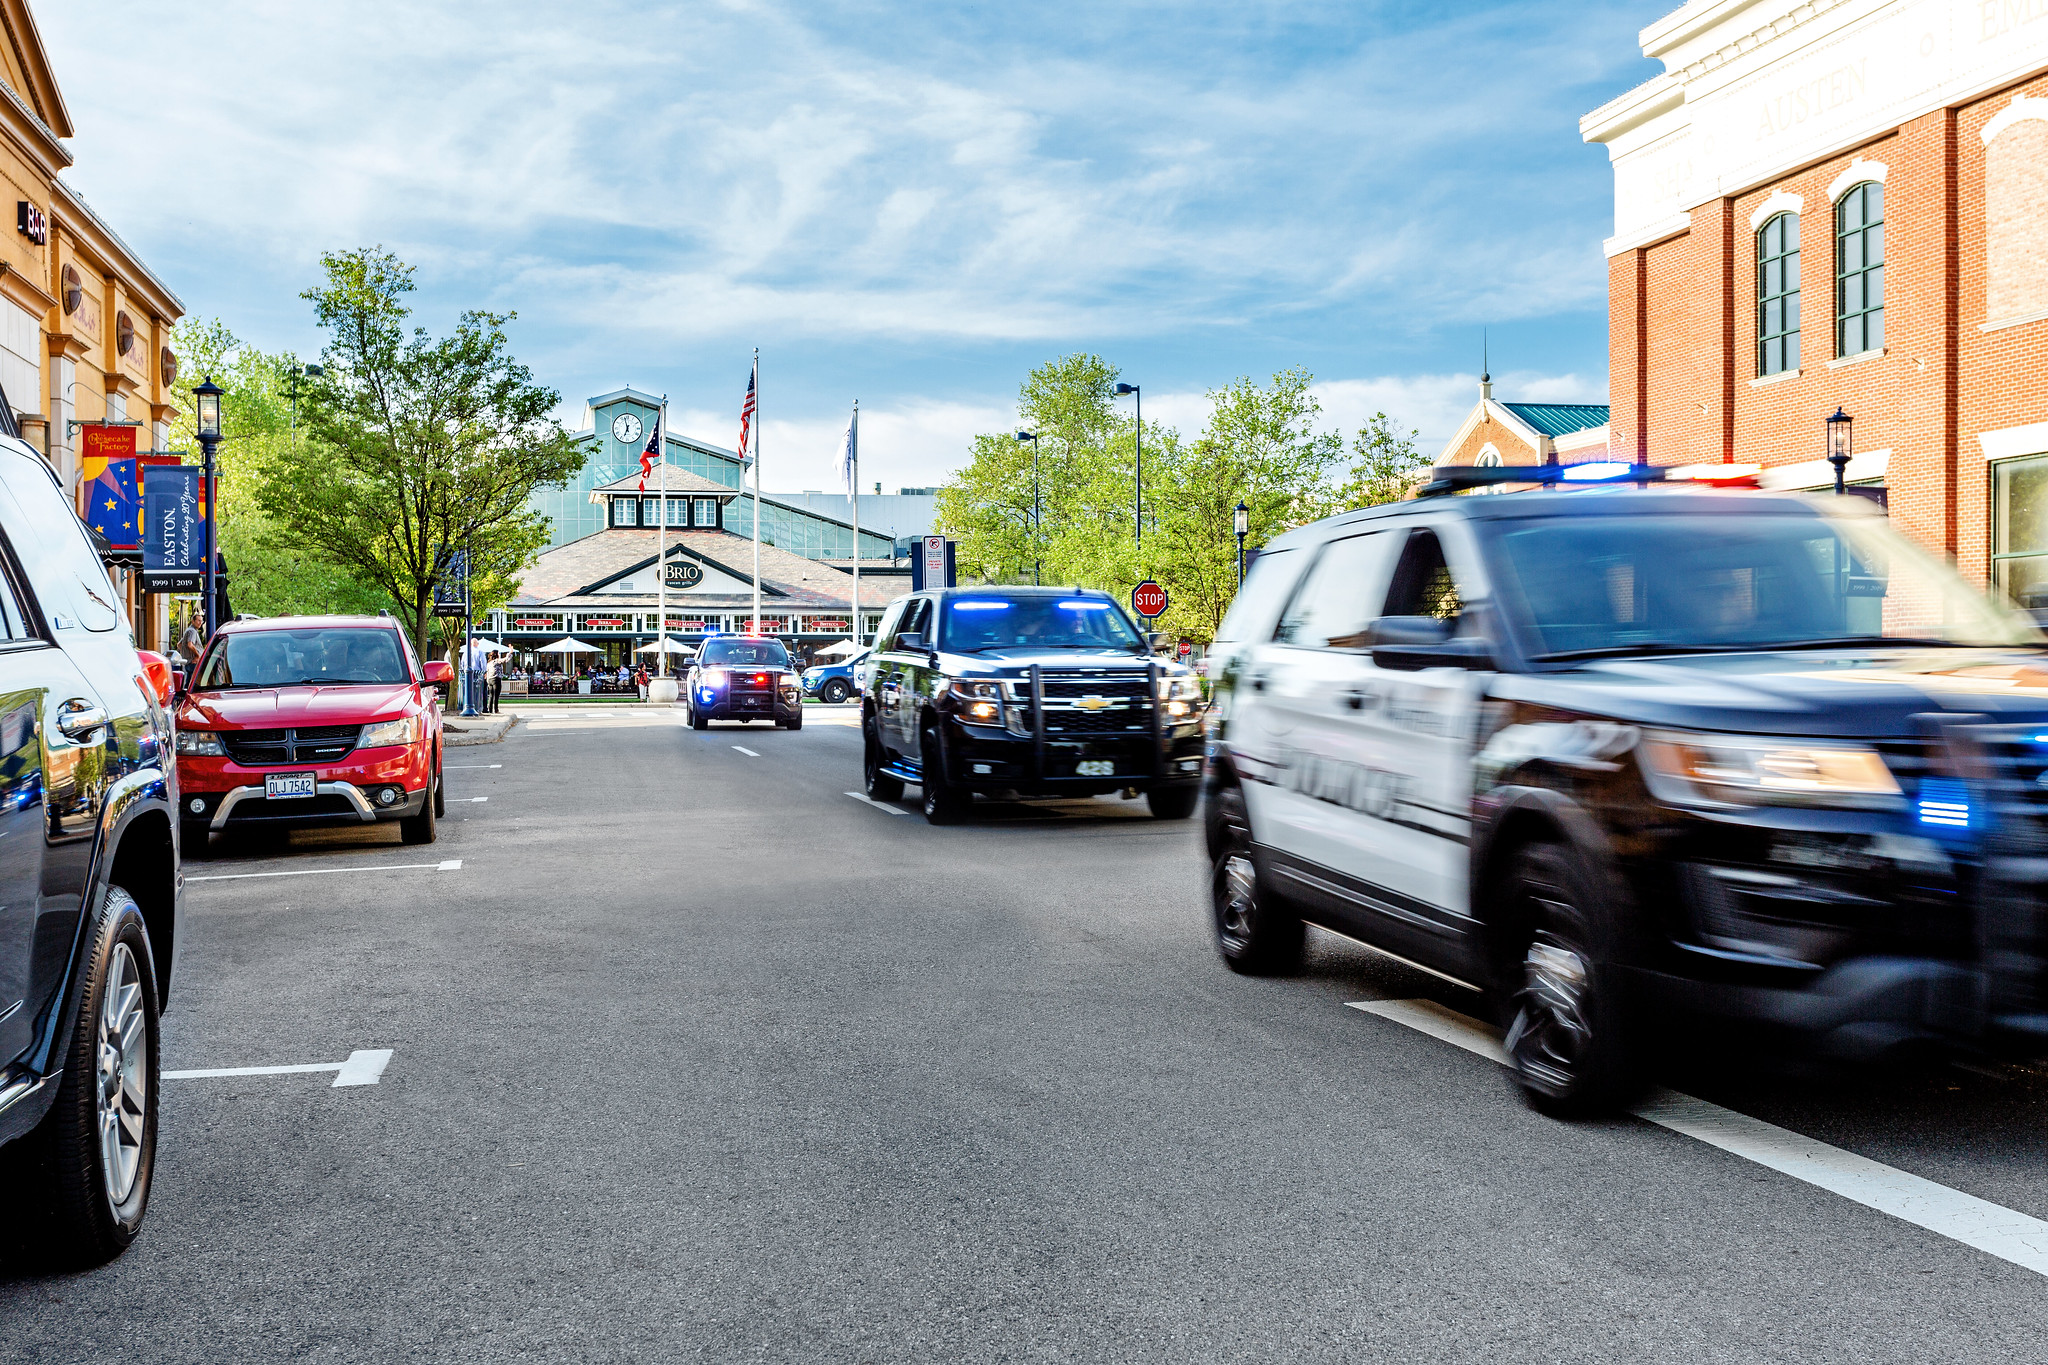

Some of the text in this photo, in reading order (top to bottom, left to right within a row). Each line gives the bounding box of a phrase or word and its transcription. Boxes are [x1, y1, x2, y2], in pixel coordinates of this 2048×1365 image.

[1755, 57, 1869, 142] AUSTEN
[28, 202, 47, 246] BAR
[88, 433, 130, 445] Cheesecake
[99, 442, 130, 453] Factory
[180, 475, 196, 567] Celebrating 20 Years
[152, 579, 193, 587] 1999 2019
[1136, 593, 1164, 606] STOP
[289, 780, 311, 793] 7542
